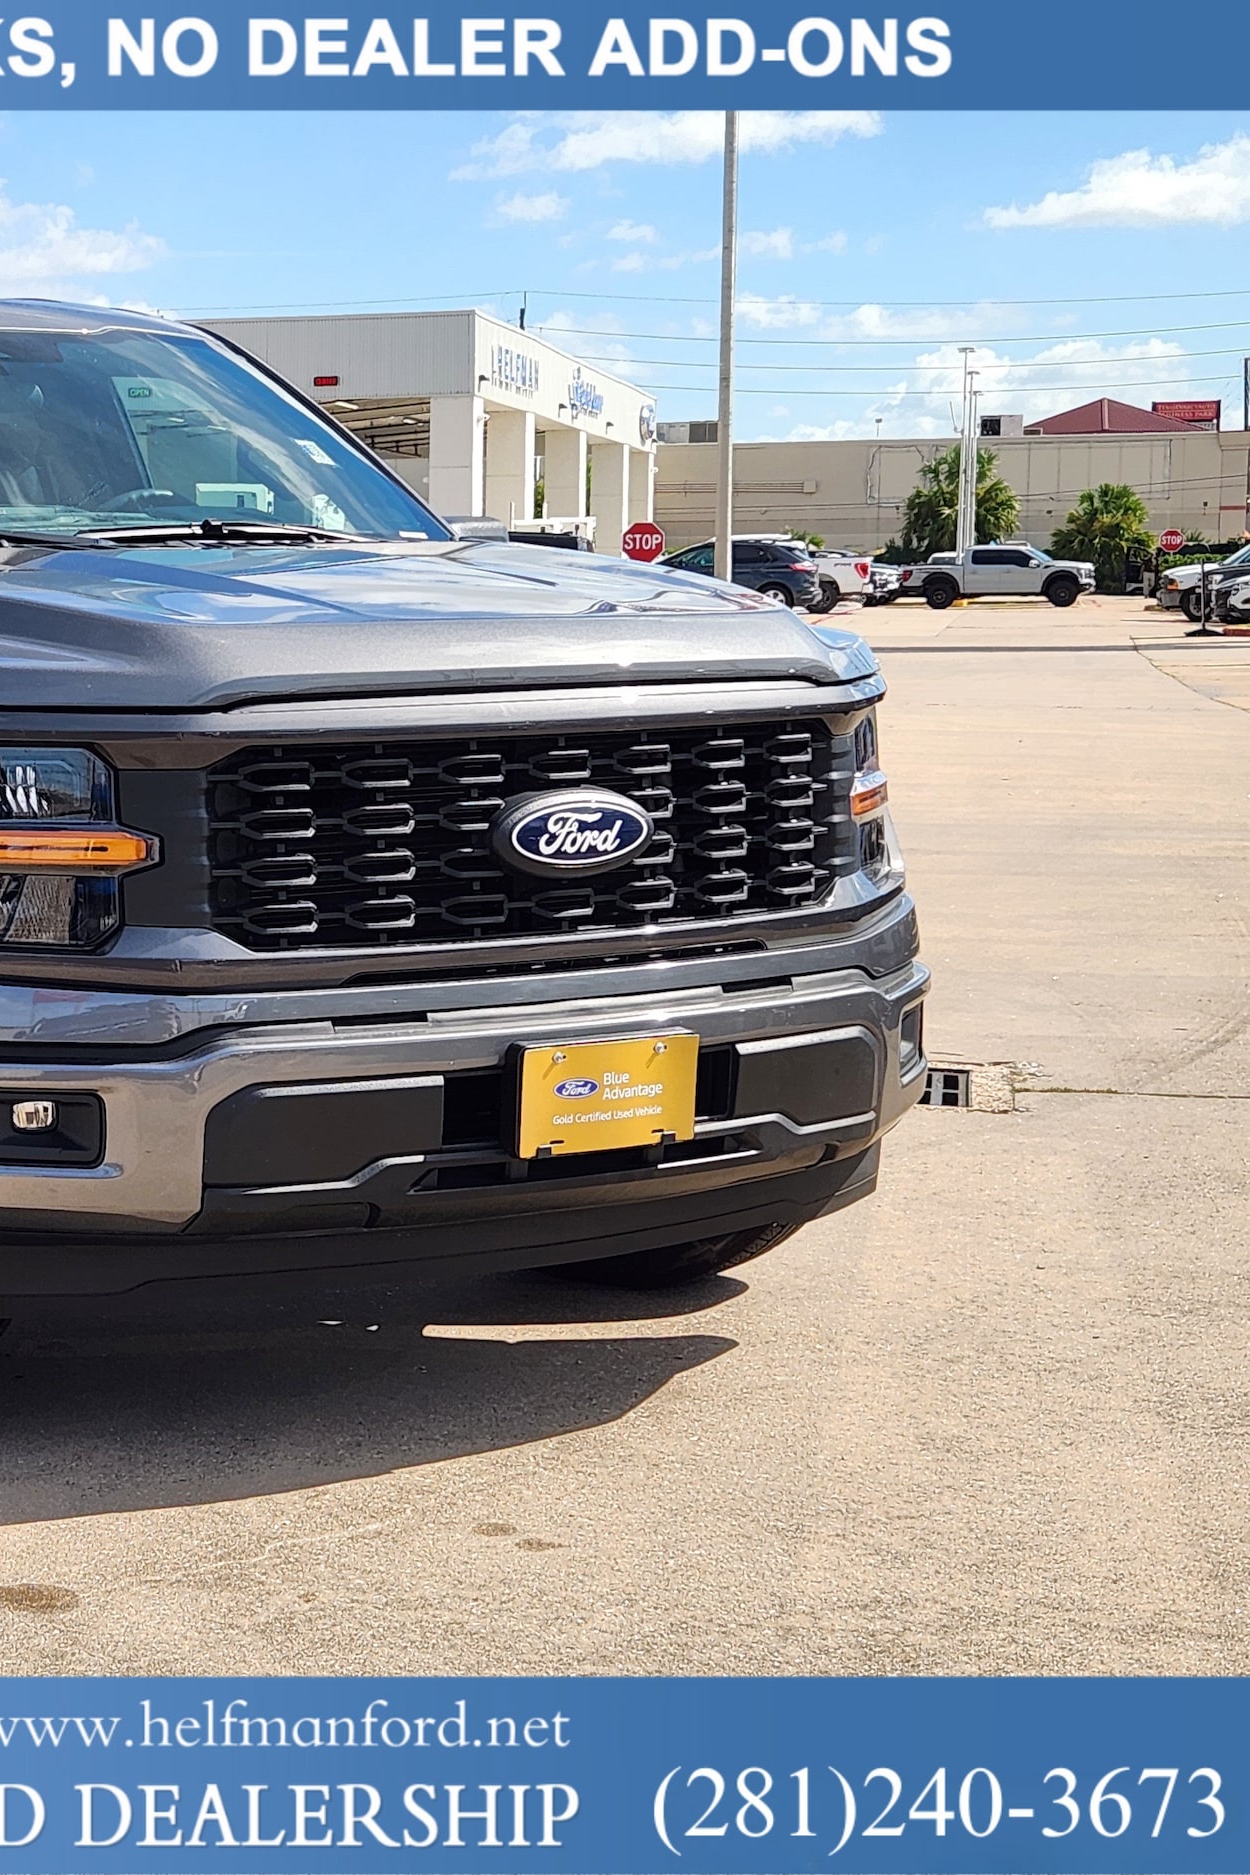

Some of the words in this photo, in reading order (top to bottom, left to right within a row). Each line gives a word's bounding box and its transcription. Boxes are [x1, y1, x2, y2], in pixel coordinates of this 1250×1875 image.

[624, 534, 662, 550] STOP
[1161, 535, 1183, 545] STOP
[539, 812, 623, 855] Ford
[603, 1071, 630, 1086] Blue
[562, 1081, 591, 1096] Ford
[602, 1082, 663, 1101] Advantage
[552, 1113, 574, 1125] Gold
[575, 1110, 612, 1122] Certified
[613, 1108, 634, 1120] Used
[635, 1105, 663, 1117] Vehicle
